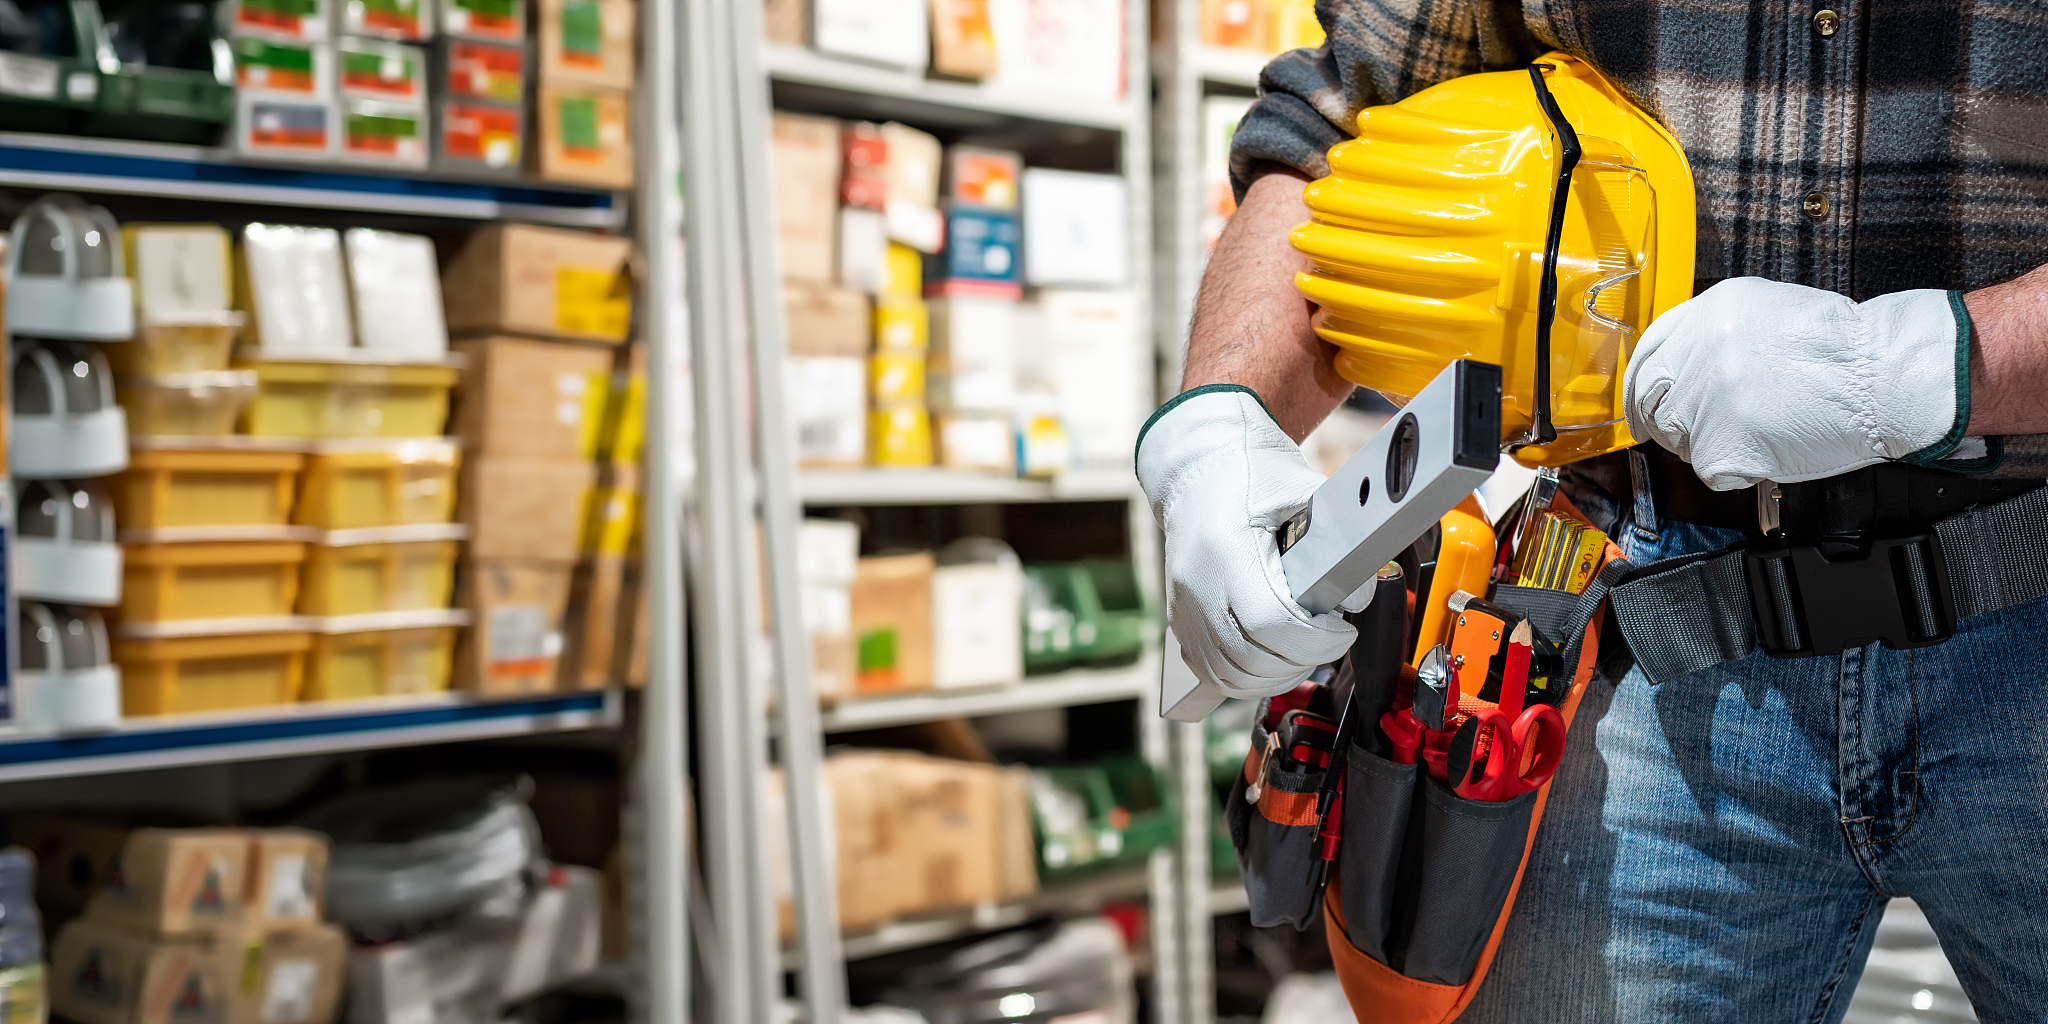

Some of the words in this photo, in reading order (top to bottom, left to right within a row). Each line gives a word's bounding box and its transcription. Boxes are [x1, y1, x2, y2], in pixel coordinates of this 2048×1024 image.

[1589, 543, 1595, 552] 21
[1578, 553, 1593, 580] 20
[1577, 582, 1583, 590] 19
